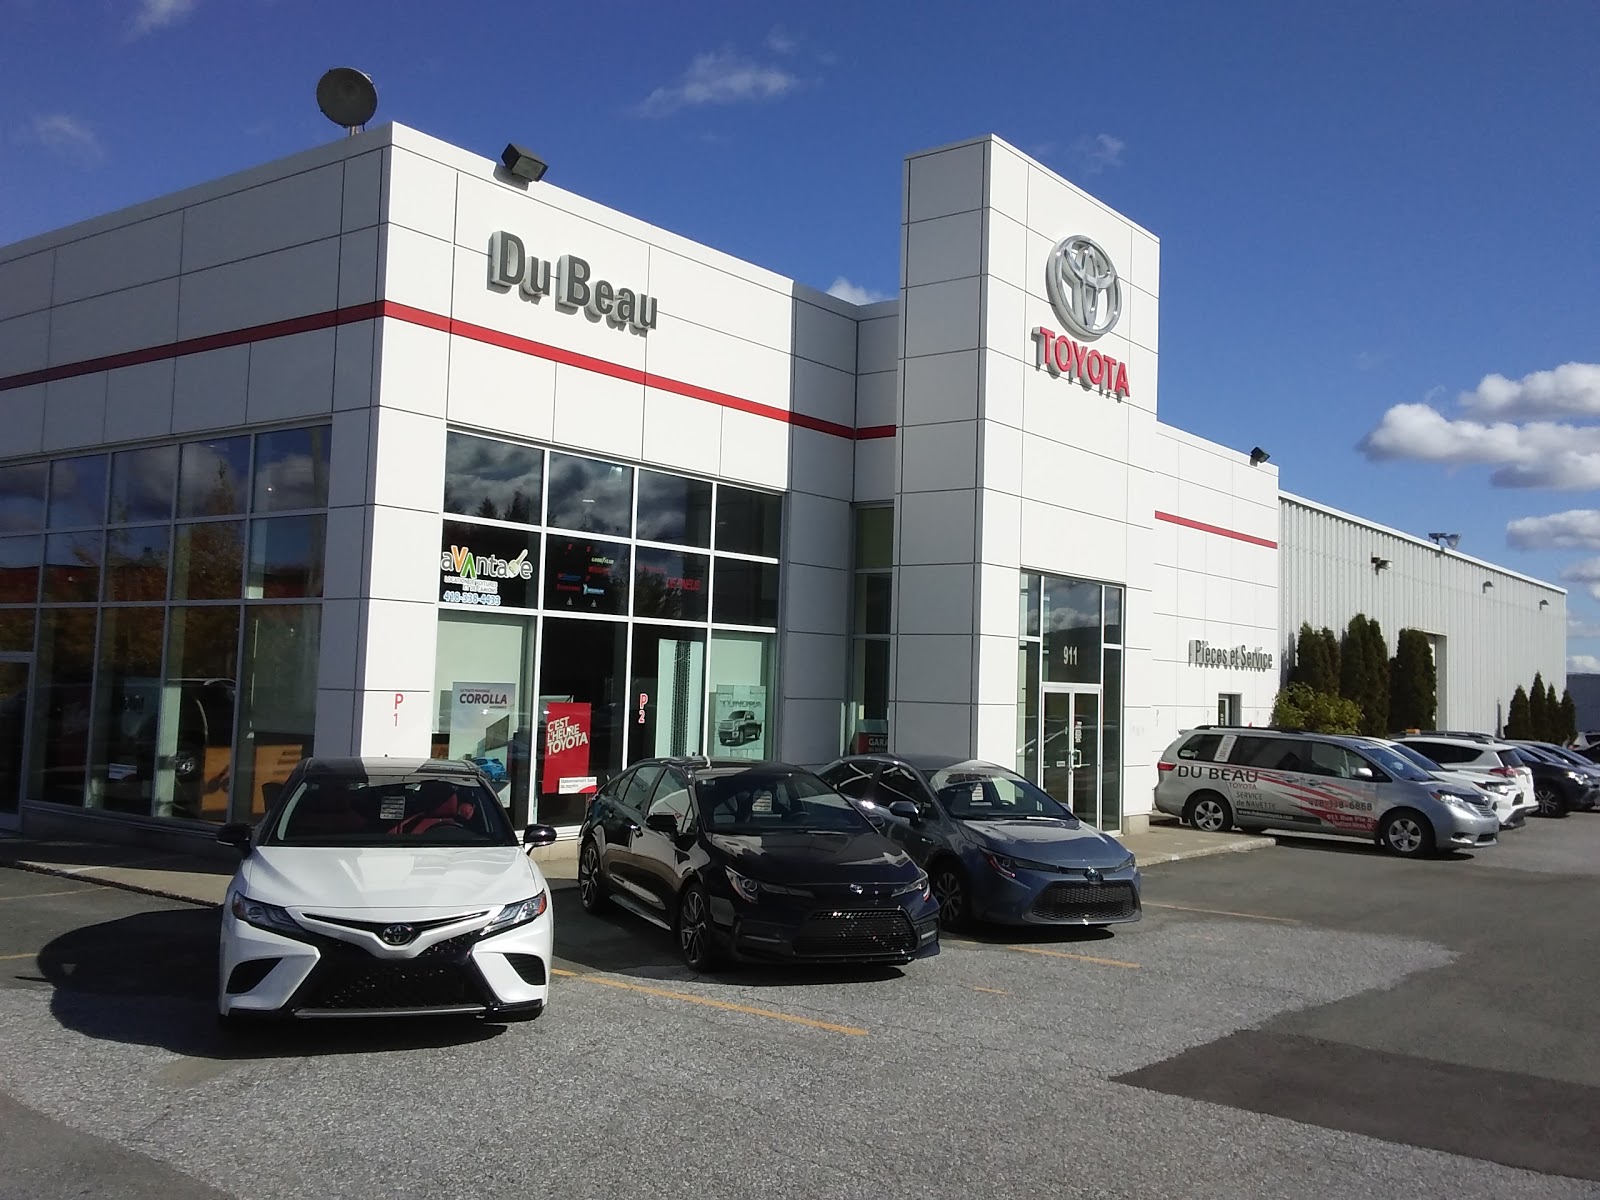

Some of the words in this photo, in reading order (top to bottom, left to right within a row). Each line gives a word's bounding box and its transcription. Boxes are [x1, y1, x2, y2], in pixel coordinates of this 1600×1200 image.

[491, 230, 551, 298] Du
[560, 254, 658, 330] Beau
[1035, 326, 1131, 398] TOYOTA
[1063, 645, 1078, 666] 911
[1230, 645, 1239, 666] et
[1241, 644, 1273, 669] Service
[394, 693, 404, 710] P
[459, 693, 508, 705] COROLLA
[639, 693, 649, 710] P
[393, 712, 399, 727] 1
[547, 716, 570, 733] C'EST
[638, 709, 646, 724] 2
[547, 723, 580, 743] L'HEURE
[547, 731, 589, 756] TOYOTA
[1178, 765, 1203, 779] DU
[1209, 768, 1259, 783] BEAU
[1229, 782, 1258, 790] TOYOTA
[1236, 791, 1264, 801] SERVICE
[1236, 799, 1245, 807] de
[1246, 800, 1276, 810] NAVETTE
